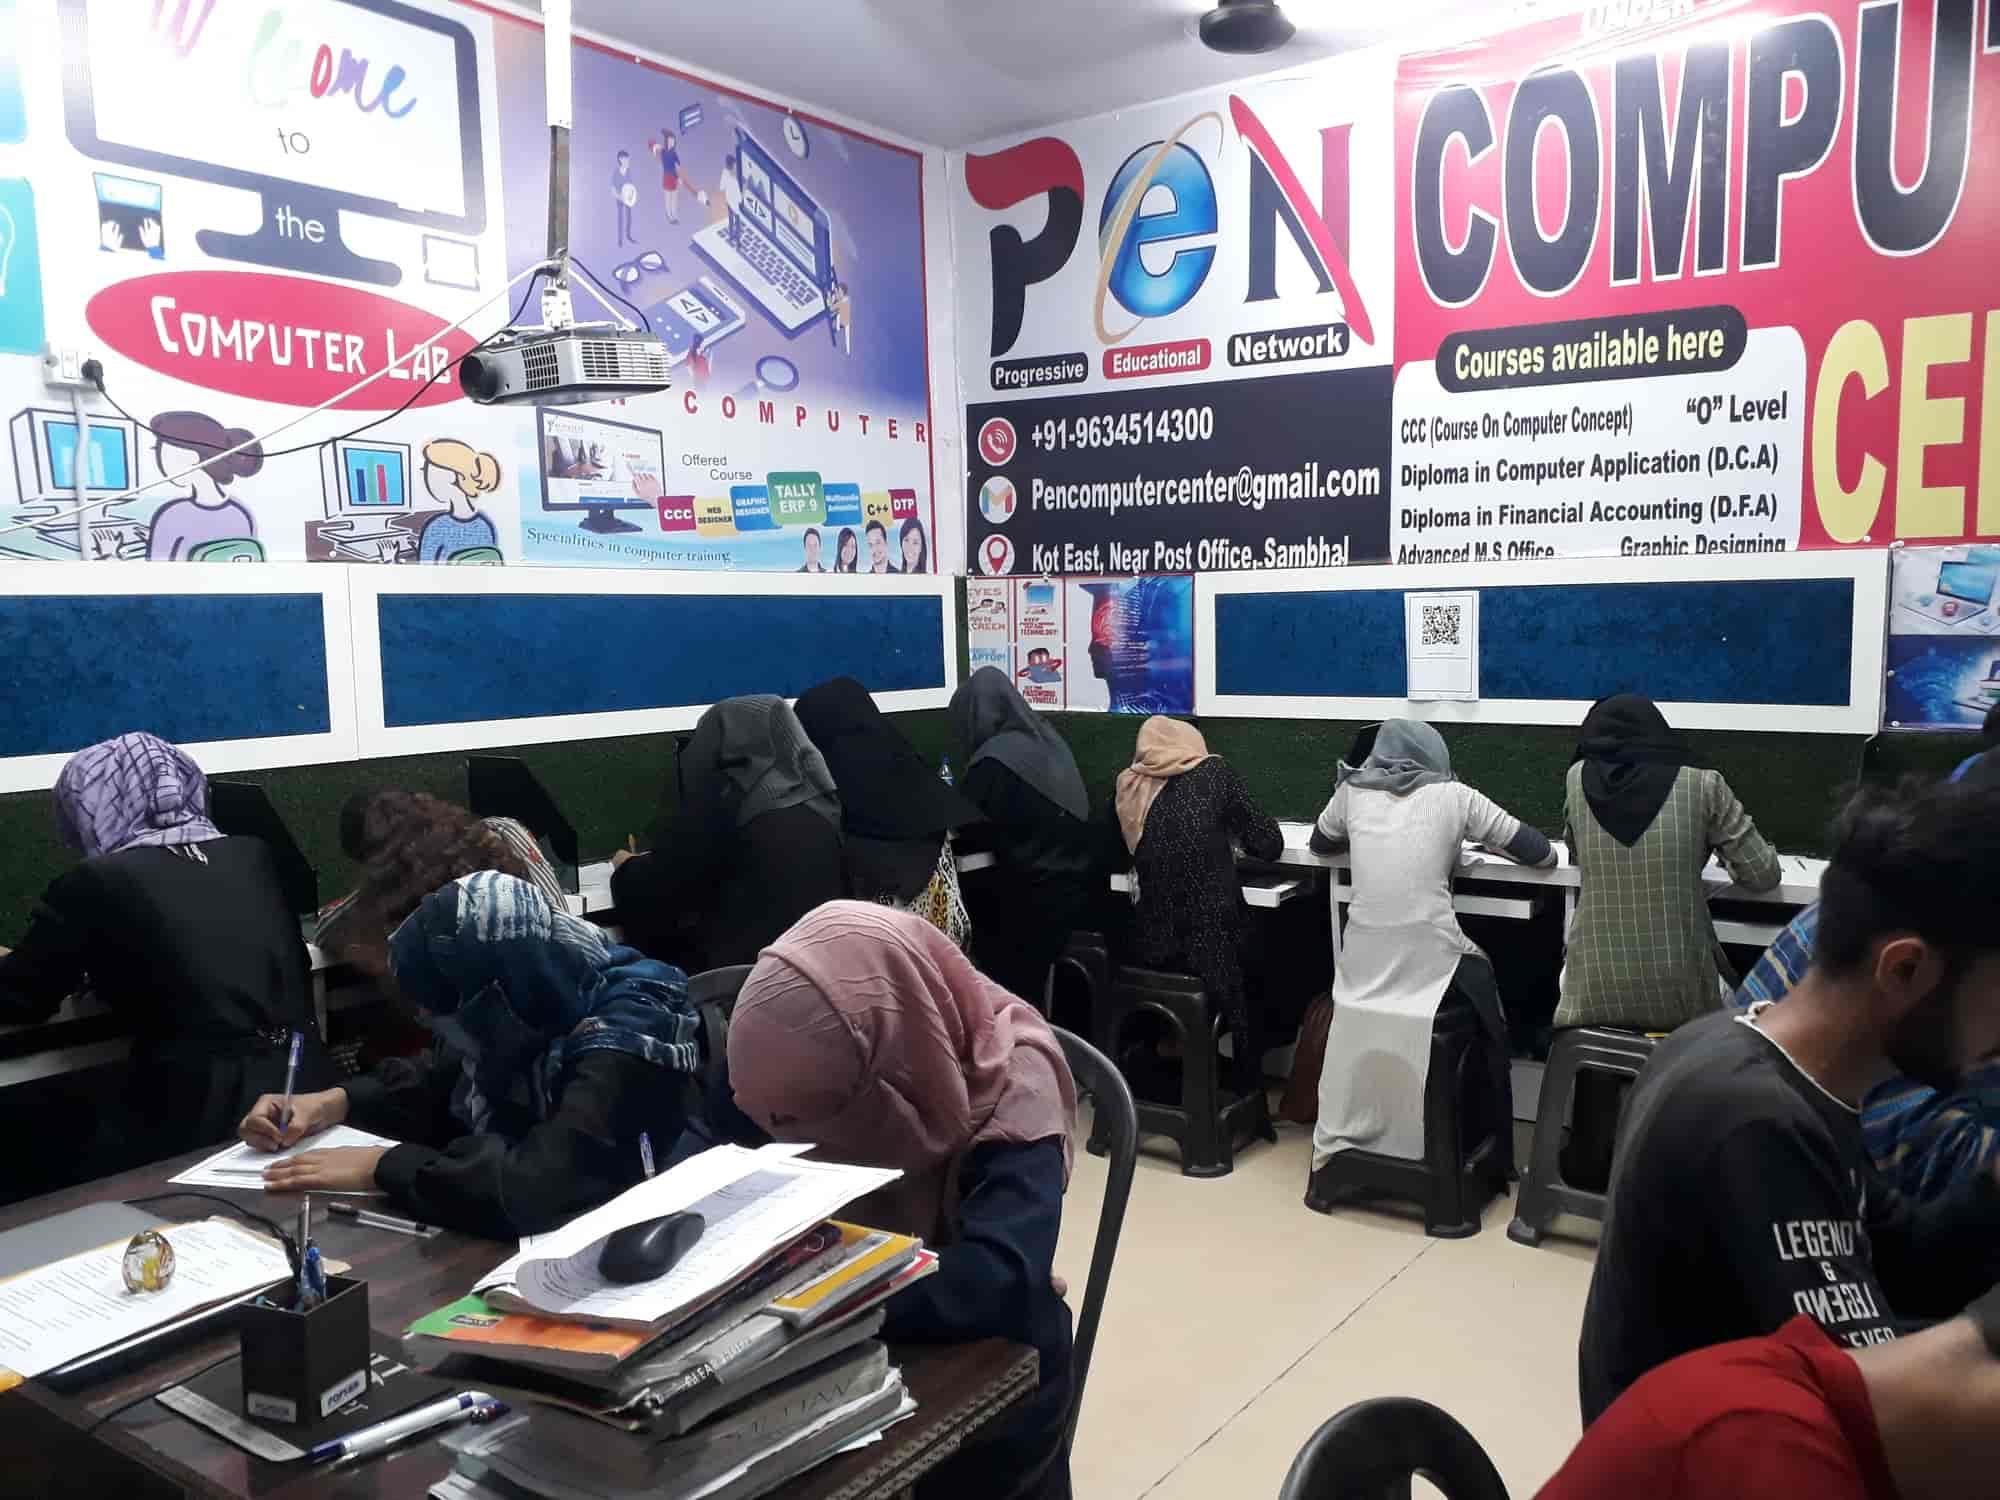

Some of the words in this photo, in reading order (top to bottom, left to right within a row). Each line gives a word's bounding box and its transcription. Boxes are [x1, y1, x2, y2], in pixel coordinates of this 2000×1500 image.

[277, 127, 311, 155] to
[1412, 0, 2000, 309] COMPU
[275, 206, 326, 243] the
[1112, 344, 1201, 375] Educational
[1233, 326, 1344, 363] Network
[1454, 342, 1545, 381] Courses
[1551, 328, 1660, 371] available
[1667, 323, 1726, 362] here
[995, 358, 1085, 386] Progressive
[1729, 391, 1788, 424] Level
[1031, 405, 1215, 451] +91-9634514300
[1400, 420, 1427, 445] CCC
[1430, 415, 1479, 449] (Course
[1481, 413, 1500, 440] On
[1503, 408, 1568, 442] Computer
[1571, 402, 1634, 438] Concept)
[1811, 310, 2000, 544] CE
[681, 454, 728, 467] Offered
[709, 469, 753, 482] Course
[1400, 462, 1470, 492] Diploma
[1474, 460, 1491, 484] in
[1495, 455, 1585, 490] Computer
[1589, 448, 1701, 484] Application
[1706, 442, 1779, 479] (D.C.A)
[773, 483, 817, 499] TALLY
[1031, 461, 1381, 516] Pencomputercenter@gmail.com
[663, 508, 693, 521] CCC
[867, 503, 889, 517] C++
[893, 498, 914, 512] DTP
[1400, 508, 1471, 534] Diploma
[1476, 507, 1493, 527] in
[1498, 501, 1584, 526] Financial
[1589, 497, 1703, 529] Accounting
[1710, 493, 1778, 525] (D.F.A)
[608, 541, 621, 552] in
[624, 545, 684, 563] computer
[1032, 543, 1060, 573] Kot
[1063, 542, 1104, 576] East,
[1109, 541, 1150, 574] Near
[1153, 540, 1193, 571] Post
[1397, 541, 1471, 565] Advanced
[1507, 540, 1555, 561] Office
[1620, 534, 1689, 557] Graphic
[1695, 531, 1787, 554] Designing
[1773, 1219, 1855, 1260] LEGEND
[1820, 1260, 1838, 1281] &
